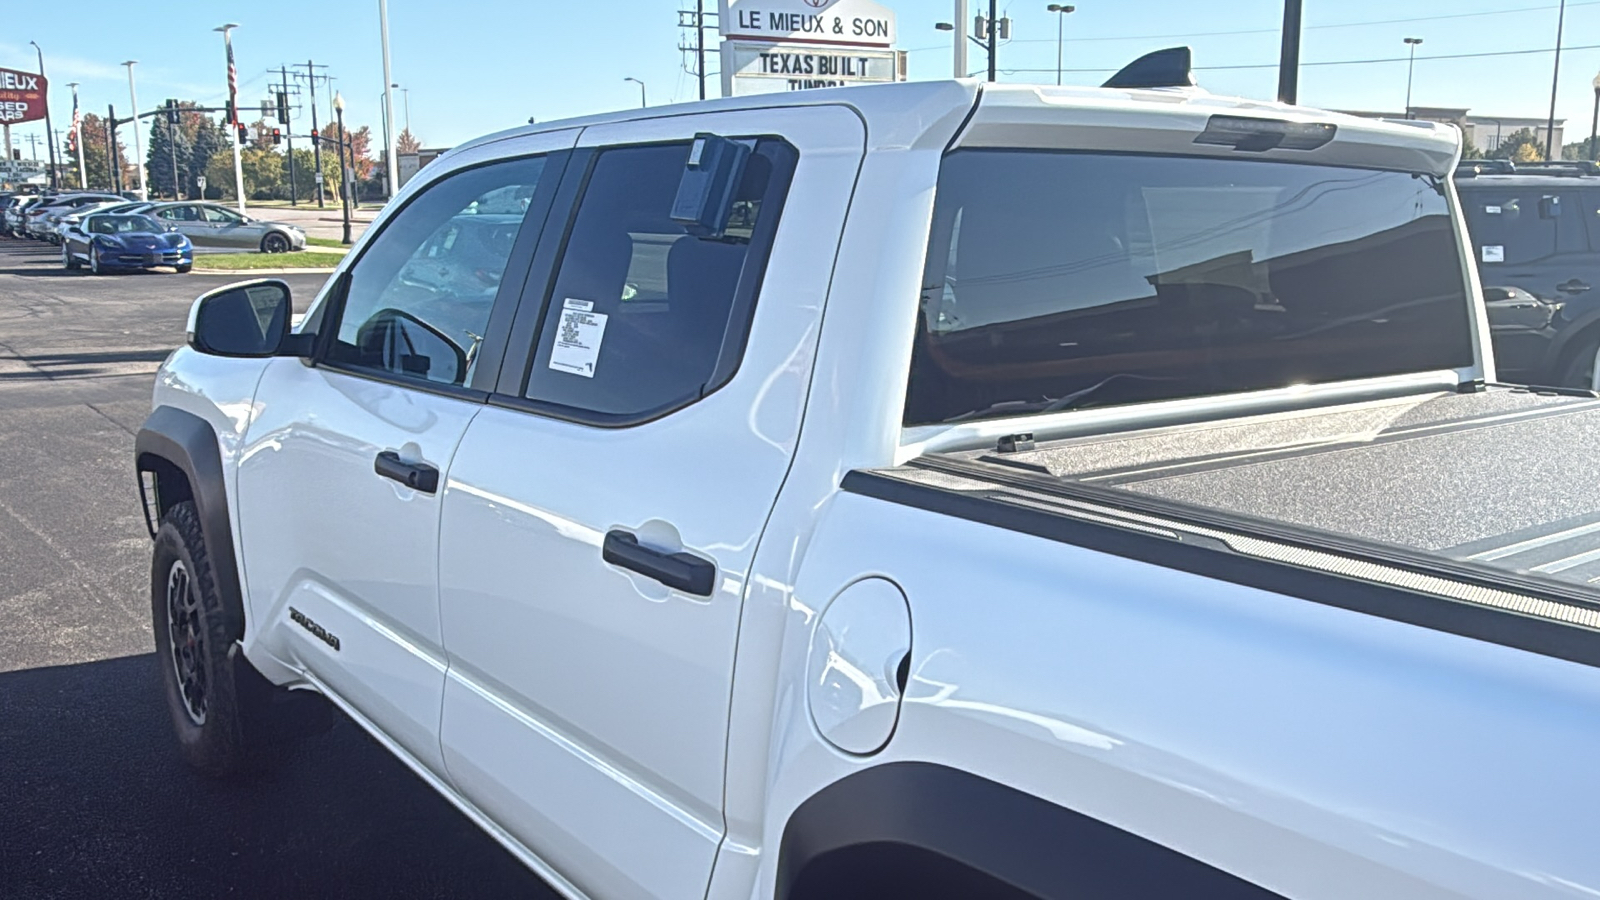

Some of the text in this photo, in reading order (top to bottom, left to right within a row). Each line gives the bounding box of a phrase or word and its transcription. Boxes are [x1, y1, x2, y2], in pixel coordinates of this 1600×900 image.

[738, 10, 889, 37] LE MIEUX & SON
[759, 53, 868, 77] TEXAS BUILT
[0, 71, 39, 90] IEUX
[787, 78, 846, 91] TUN
